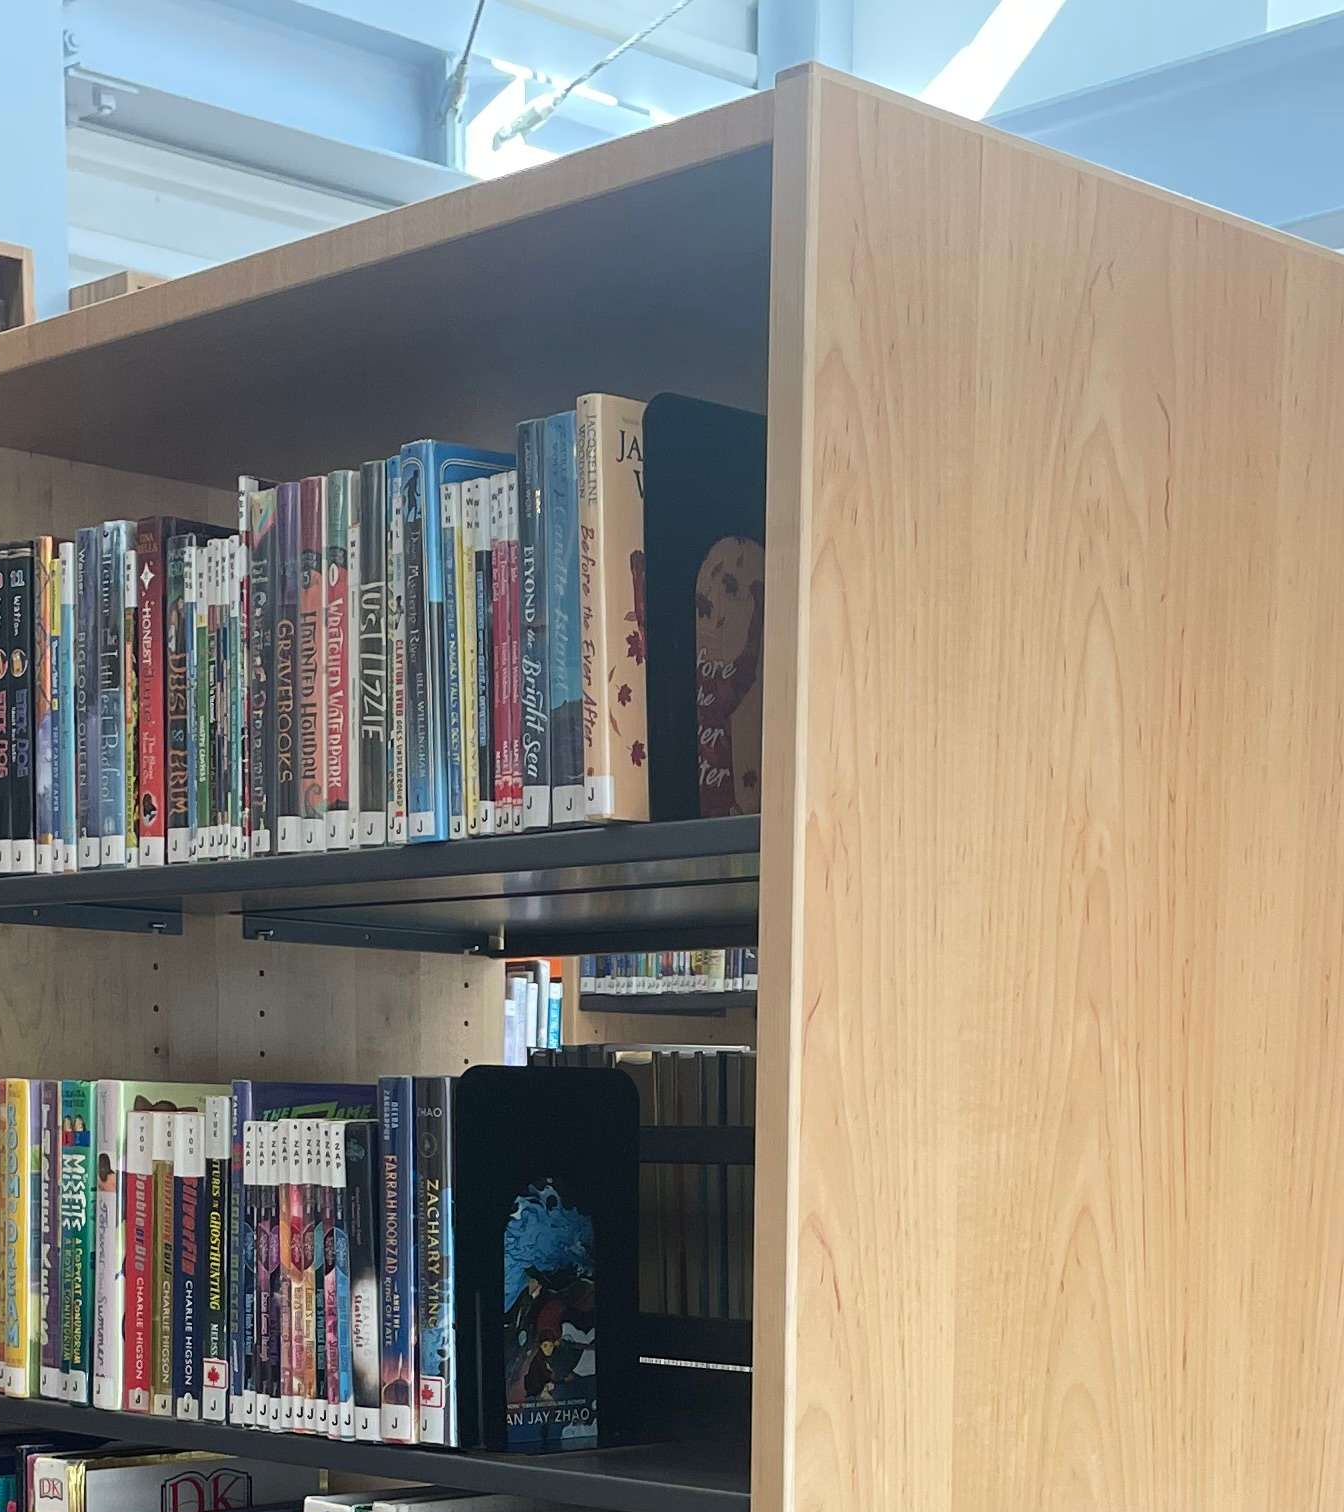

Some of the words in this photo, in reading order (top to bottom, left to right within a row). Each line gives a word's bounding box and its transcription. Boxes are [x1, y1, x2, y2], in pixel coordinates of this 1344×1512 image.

[523, 544, 536, 623] BEYOND
[580, 524, 597, 596] Before
[142, 607, 153, 666] HONEST
[395, 639, 404, 687] CLAYTON
[521, 648, 544, 720] Bright
[581, 639, 596, 691] Ever
[276, 619, 295, 784] GRAVEBOOKS
[580, 693, 594, 749] After
[426, 1179, 440, 1275] ZACHARY
[208, 1212, 222, 1312] GHOSTHUNTING
[135, 1276, 144, 1330] CHARLIE
[161, 1280, 171, 1334] CHARLIE
[184, 1280, 194, 1334] CHARLIE
[427, 1282, 440, 1328] YING
[135, 1333, 144, 1381] HIGSON
[161, 1335, 170, 1384] HIGSON
[184, 1336, 193, 1386] HIGSON
[527, 1410, 552, 1426] JAY
[555, 1407, 590, 1423] ZHAO
